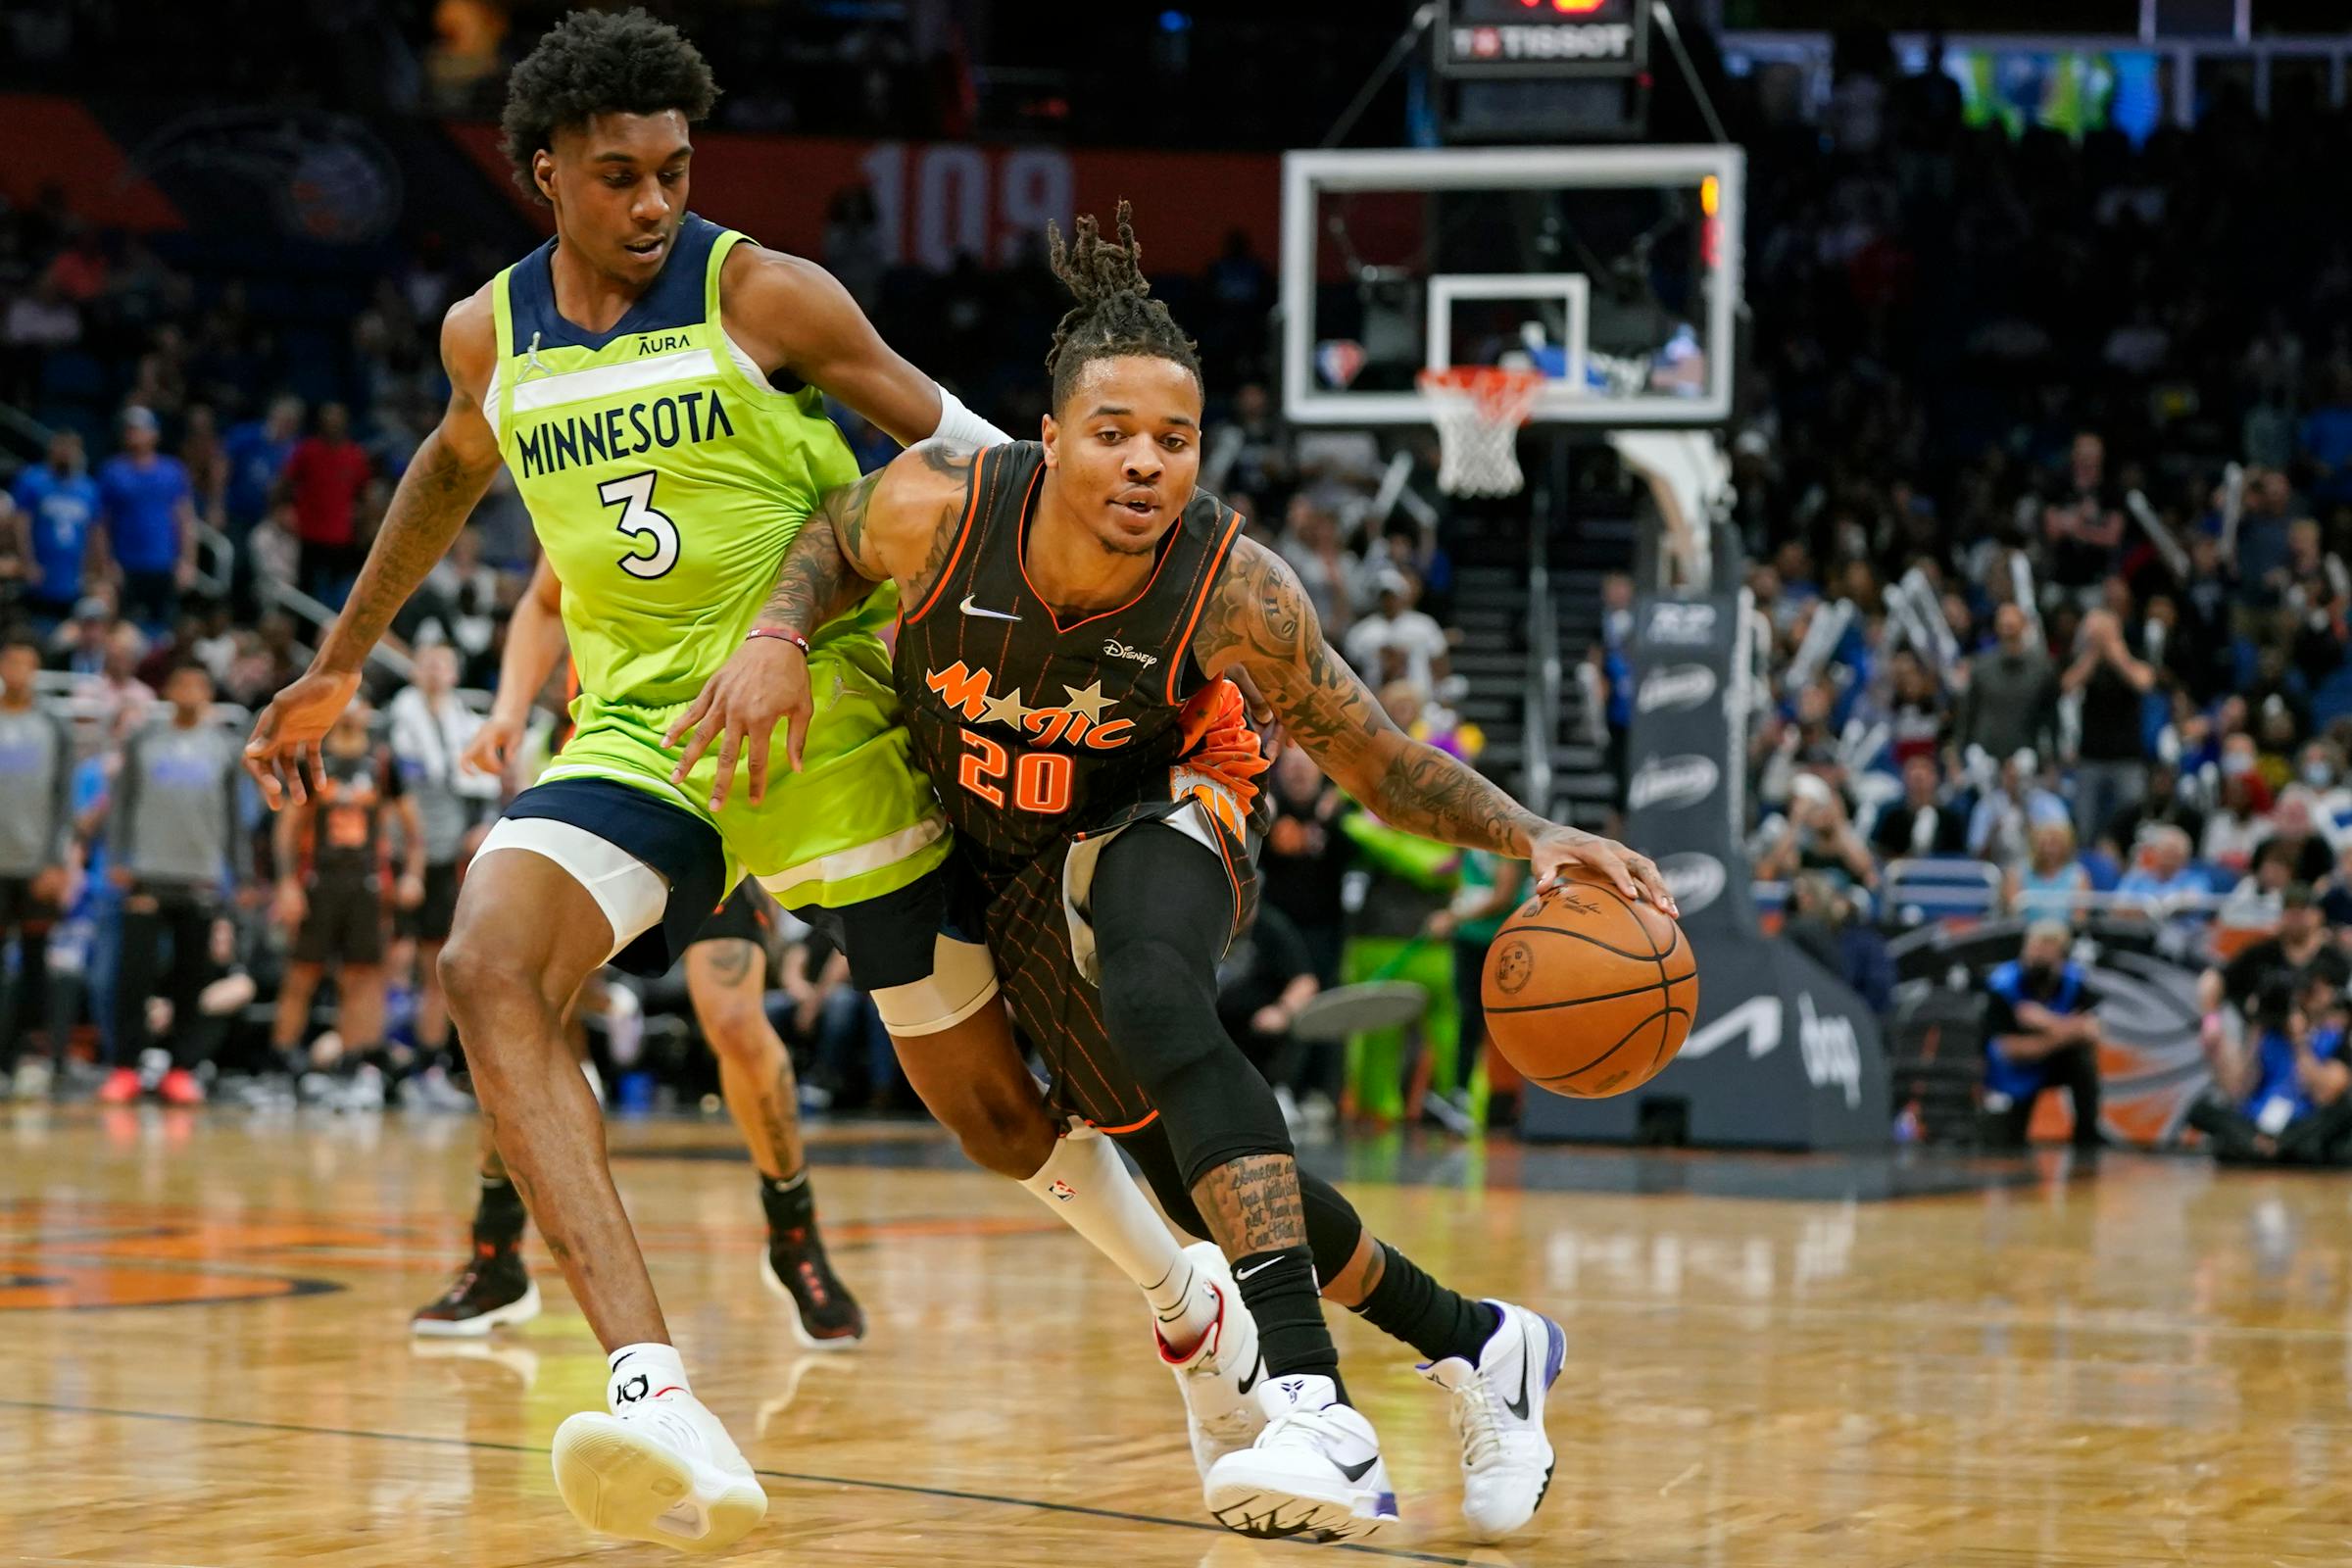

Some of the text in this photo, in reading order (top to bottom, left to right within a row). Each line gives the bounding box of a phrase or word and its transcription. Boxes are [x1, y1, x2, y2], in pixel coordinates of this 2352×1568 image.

[1501, 24, 1634, 58] TISSOT
[862, 143, 1072, 269] 109
[515, 389, 734, 479] MINNESOTA
[597, 469, 681, 580] 3
[958, 727, 1074, 814] 20
